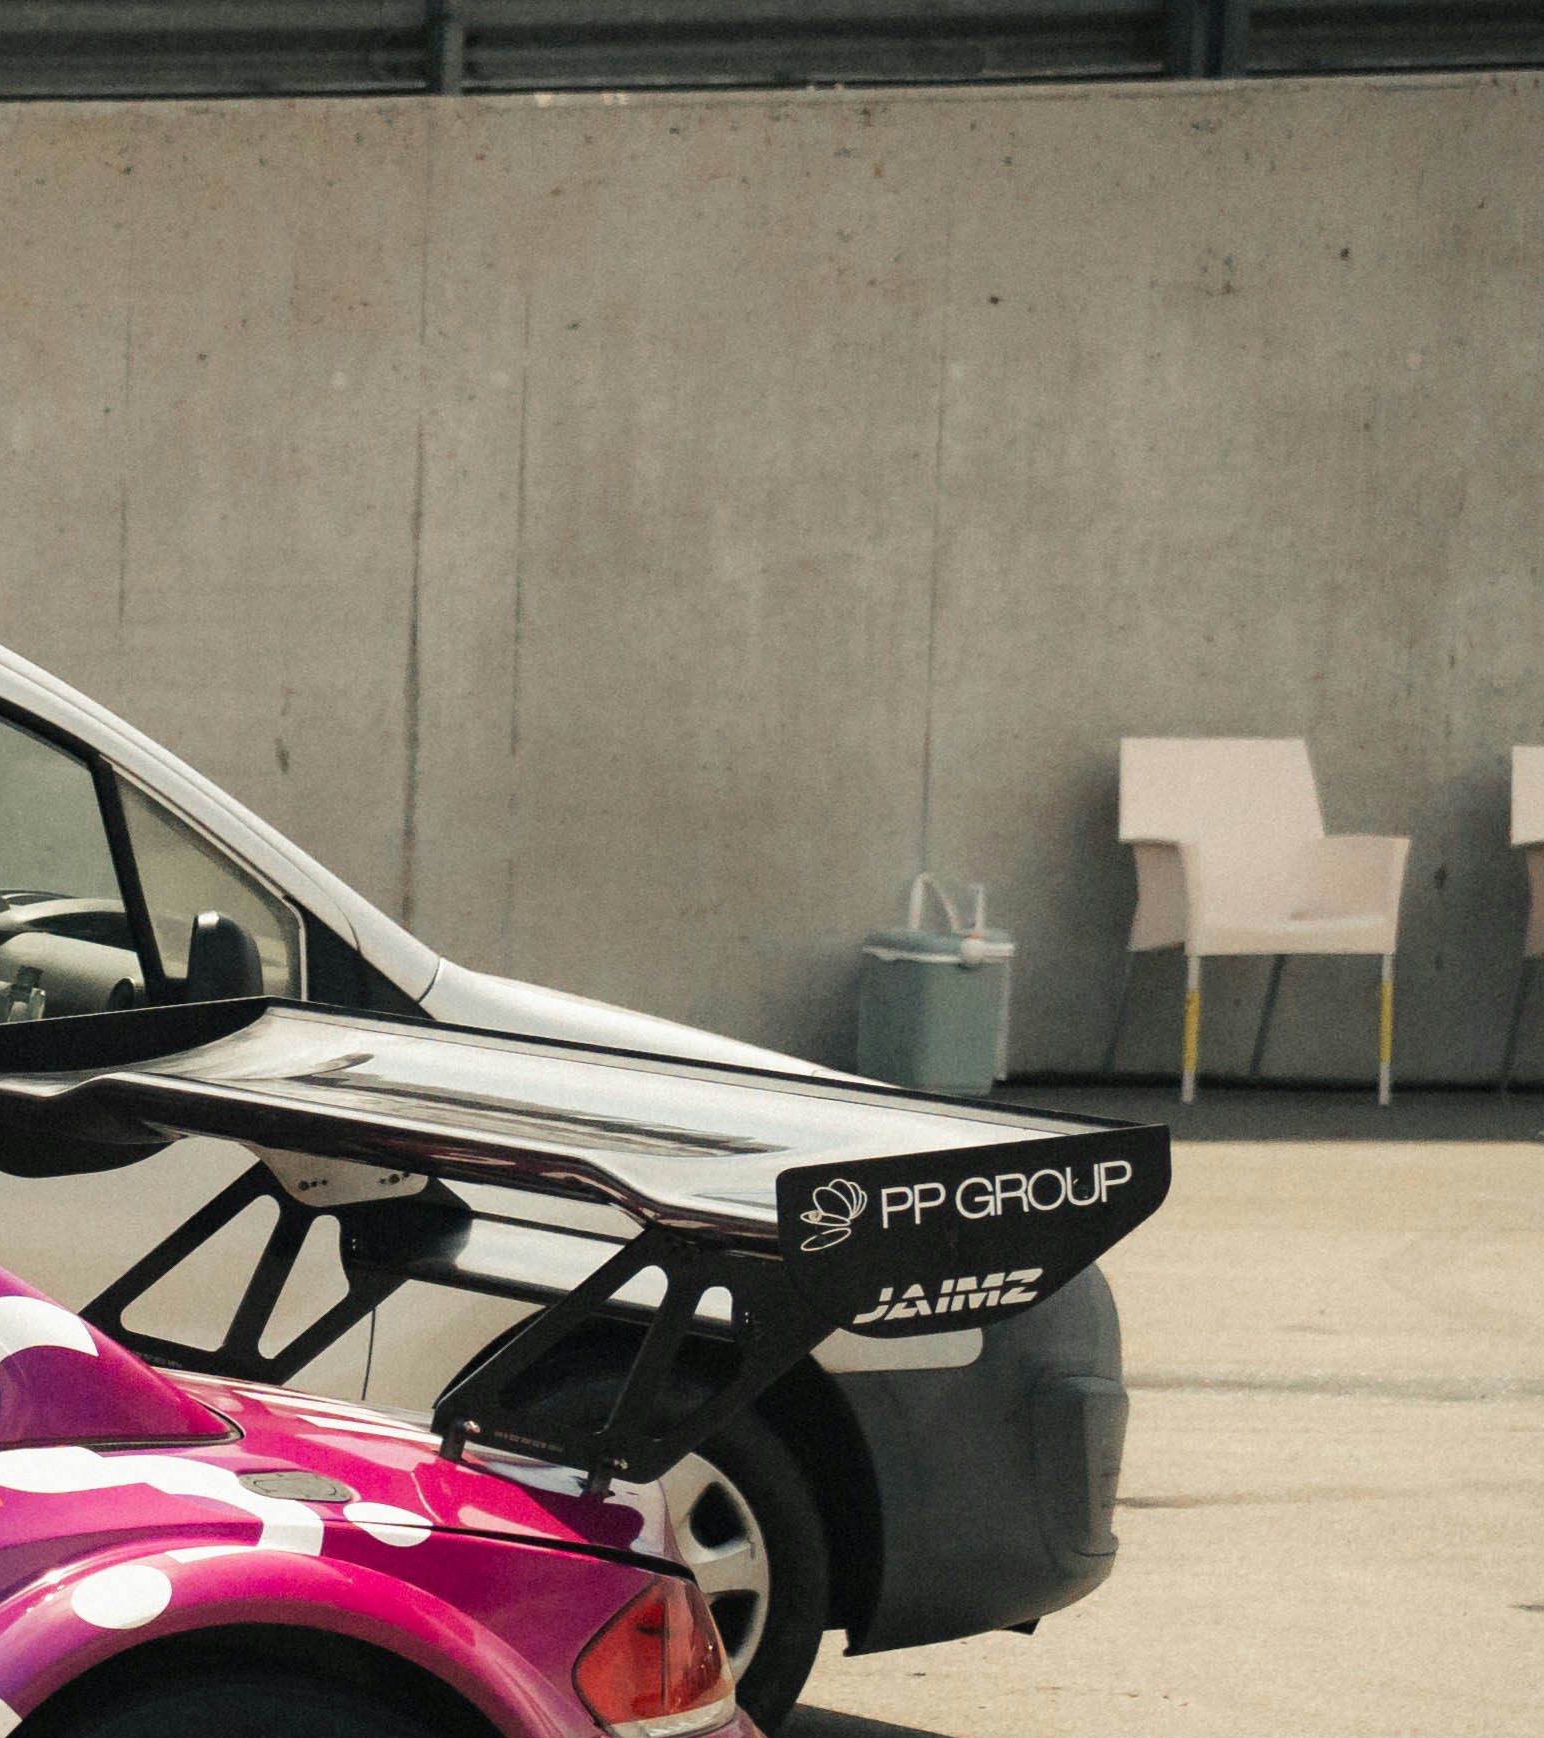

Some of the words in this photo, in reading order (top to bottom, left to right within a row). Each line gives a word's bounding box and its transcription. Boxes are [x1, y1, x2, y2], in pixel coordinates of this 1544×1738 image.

[881, 1182, 947, 1229] PP
[955, 1159, 1133, 1218] GROUP
[853, 1268, 1044, 1325] JAIMZ
